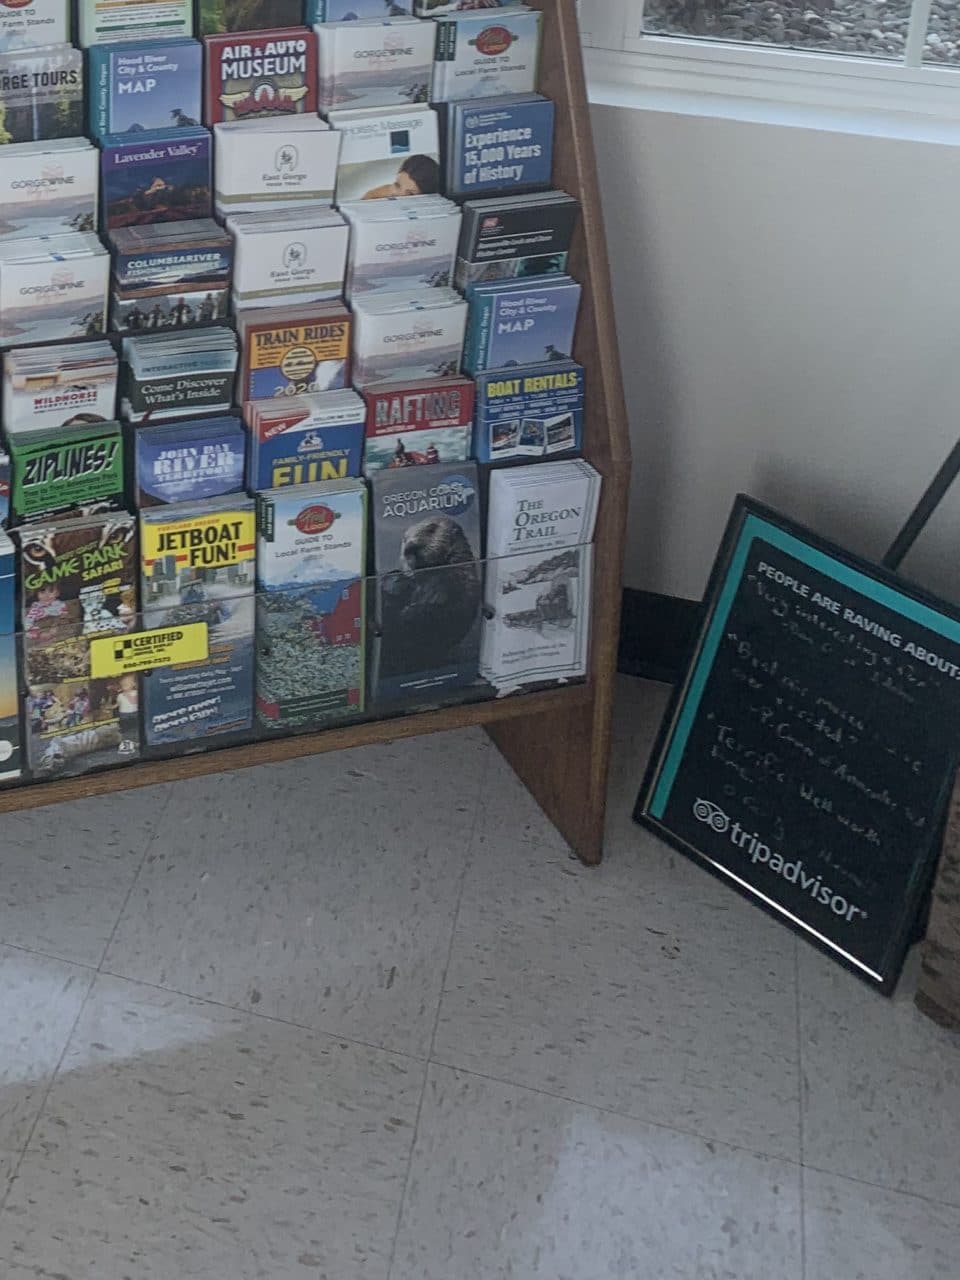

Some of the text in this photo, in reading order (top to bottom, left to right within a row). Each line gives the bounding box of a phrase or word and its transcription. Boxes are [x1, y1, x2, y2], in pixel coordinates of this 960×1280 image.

[221, 39, 307, 60] AIR & AUTO
[221, 55, 306, 81] MUSEUM
[32, 69, 78, 89] TOURS
[118, 79, 157, 95] MAP
[465, 128, 532, 149] Experience
[115, 145, 197, 164] Lavender Valley
[464, 143, 541, 167] 15,000 Years
[464, 164, 524, 184] of History
[255, 324, 345, 348] TRAIN RIDES
[497, 319, 535, 334] MAP
[141, 377, 227, 395] Come Discover
[144, 387, 221, 404] What's Inside
[274, 382, 320, 397] 2020
[488, 372, 577, 398] BOAT RENTALS
[34, 392, 97, 405] WILDHORSE
[375, 391, 460, 426] RAFTING
[264, 422, 287, 438] NEW
[158, 442, 232, 459] JOHN DAY
[22, 441, 119, 488] ZIPLINES!
[153, 452, 234, 475] RIVER
[272, 458, 348, 487] FUN
[382, 494, 467, 518] AQUARIUM
[383, 490, 427, 504] OREGON
[517, 499, 544, 513] THE
[514, 506, 581, 527] OREGON
[157, 521, 243, 552] JETBOAT
[513, 526, 558, 541] TRAIL
[190, 542, 237, 567] FUN!
[24, 561, 80, 589] GAME
[83, 542, 128, 565] PARK
[83, 559, 123, 580] SAFARI
[758, 561, 810, 597] PEOPLE
[810, 590, 841, 615] ARE
[843, 608, 902, 648] RAVING
[133, 631, 183, 648] CERTIFIED
[730, 821, 860, 922] tripadvisor
